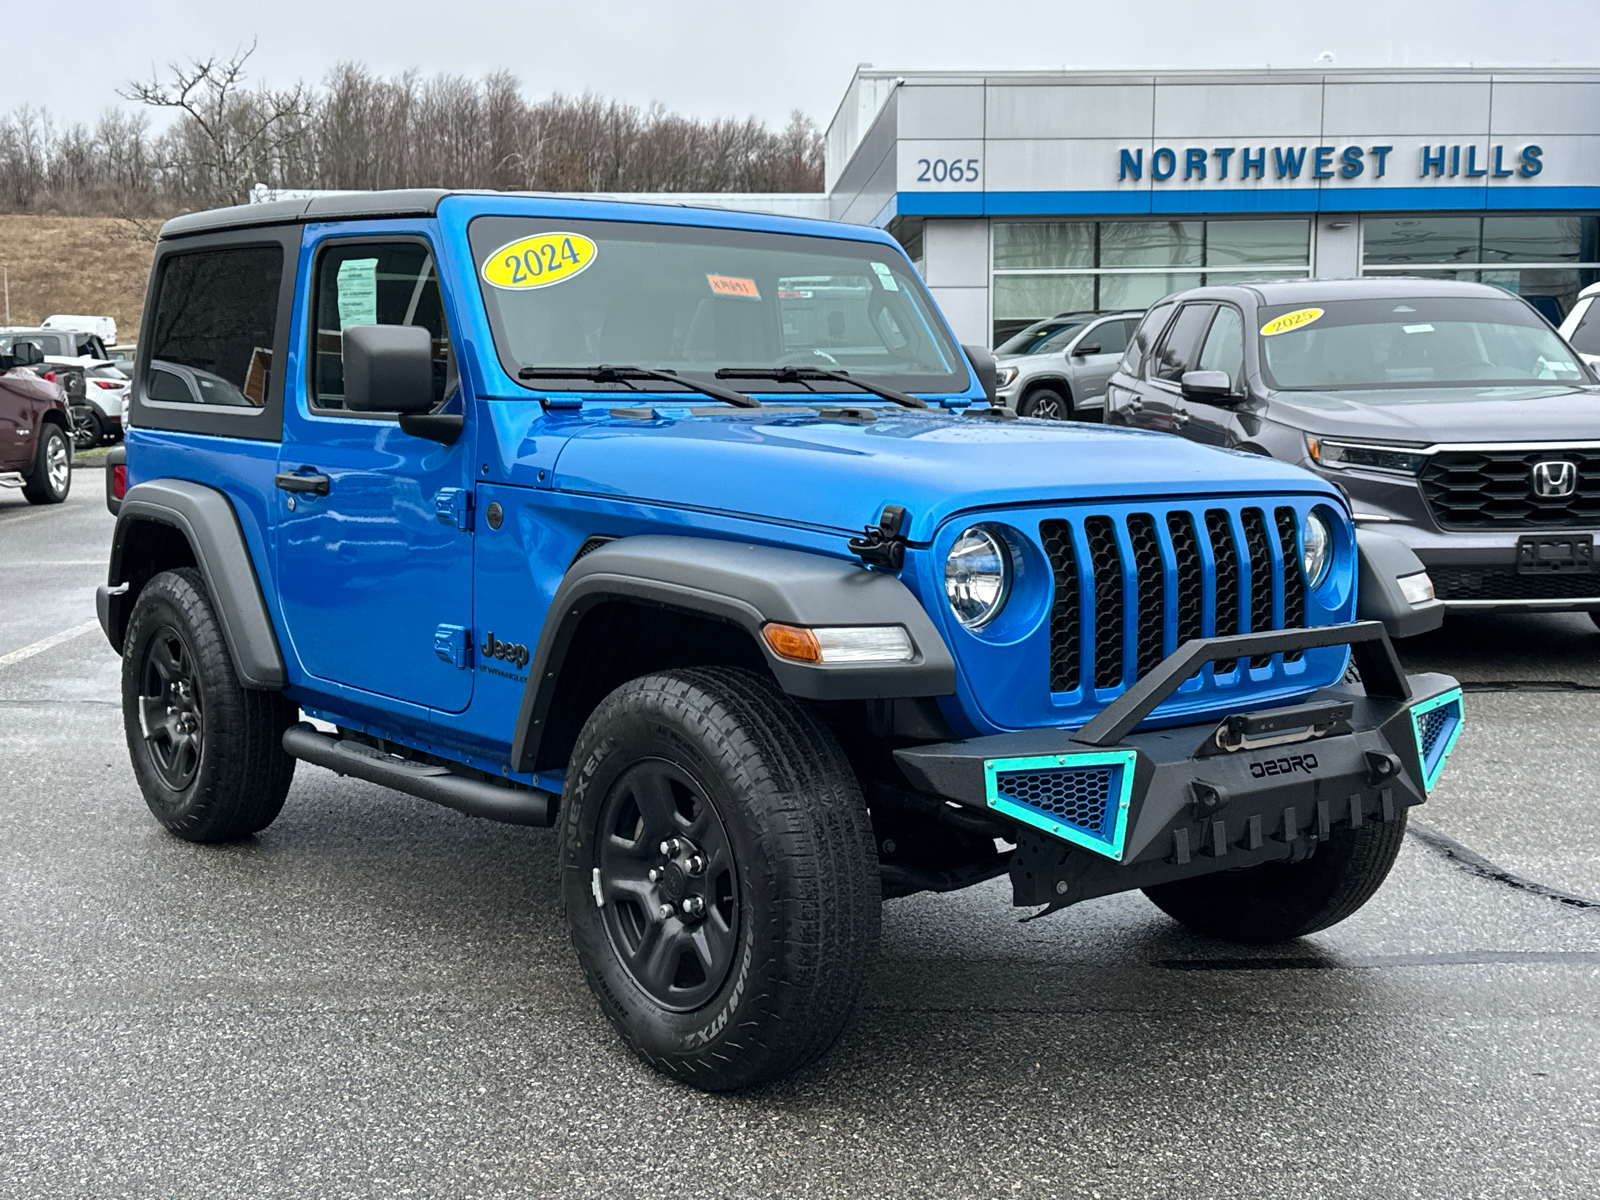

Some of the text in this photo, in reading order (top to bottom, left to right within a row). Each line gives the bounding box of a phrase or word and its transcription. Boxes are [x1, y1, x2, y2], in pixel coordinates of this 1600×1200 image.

[917, 158, 979, 182] 2065
[1118, 145, 1544, 181] NORTHWEST HILLS
[504, 237, 580, 284] 2024
[1272, 311, 1314, 332] 2025
[480, 631, 529, 670] Jeep
